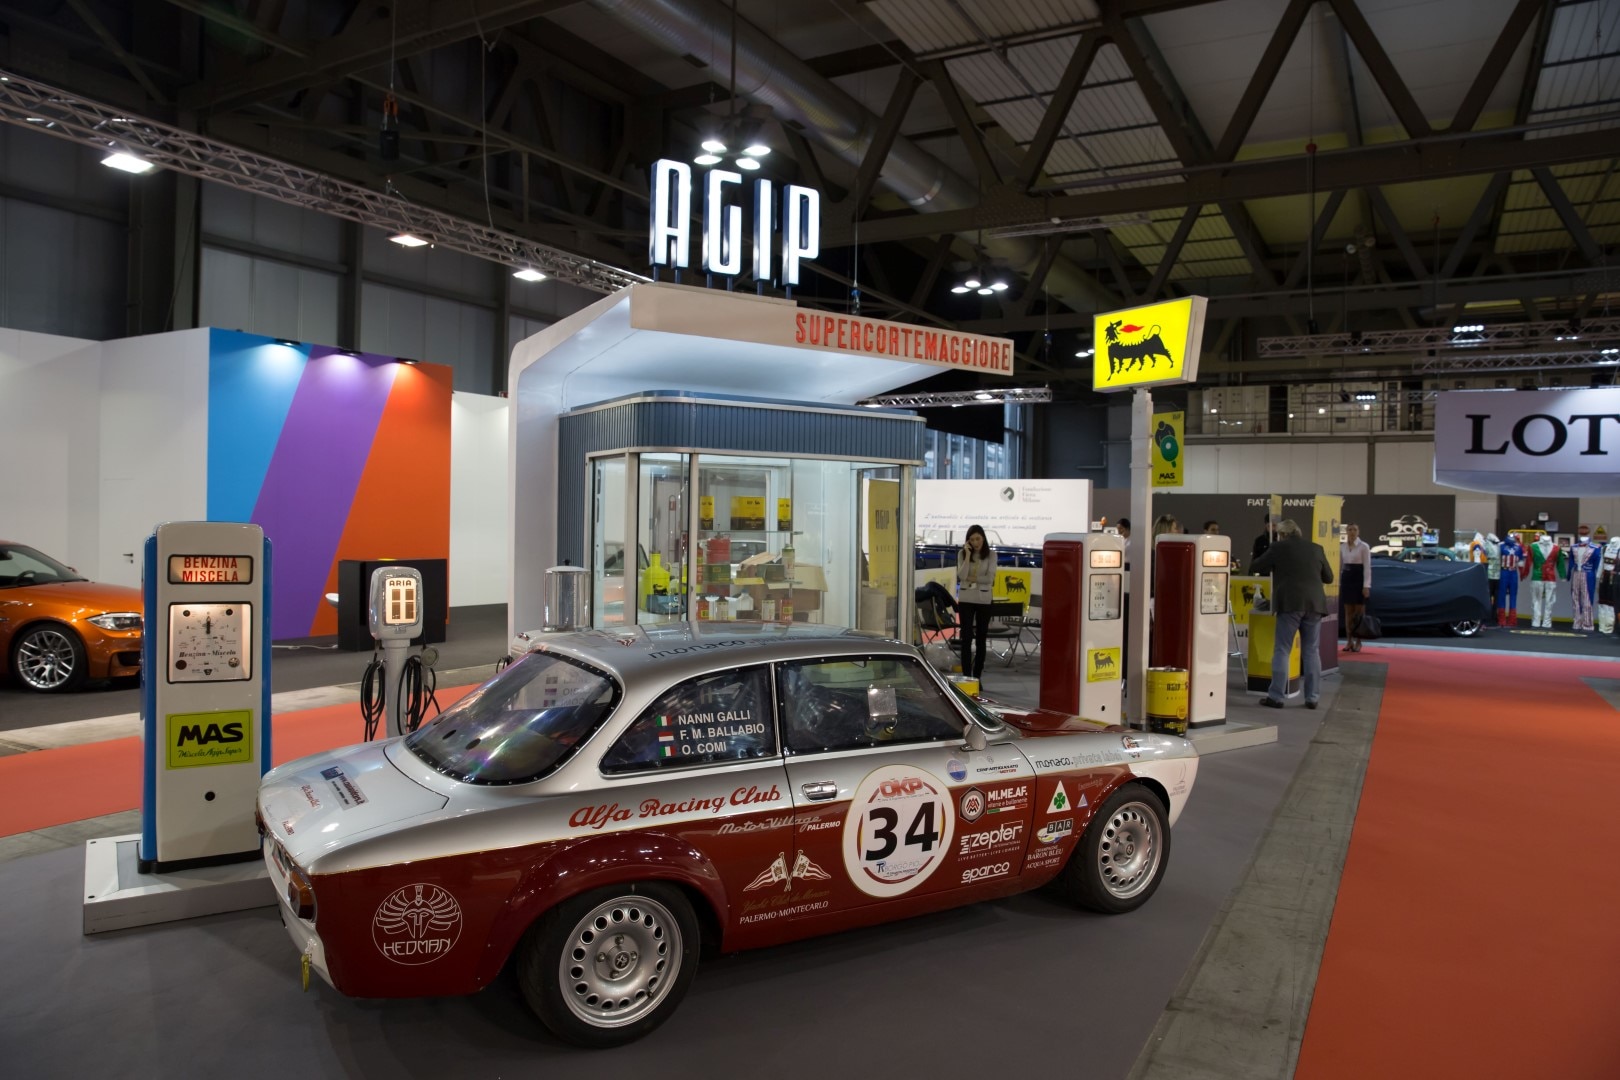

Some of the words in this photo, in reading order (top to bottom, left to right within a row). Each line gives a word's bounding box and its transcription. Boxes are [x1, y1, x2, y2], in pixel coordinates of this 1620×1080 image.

[649, 158, 821, 287] AGIP
[795, 312, 1011, 371] SUPERCORTEMAGGIORE
[1465, 413, 1620, 456] LOT
[184, 556, 238, 569] BENZINA
[182, 570, 239, 582] MISCELA
[678, 713, 715, 726] NANNI
[717, 710, 751, 721] GALLI
[177, 722, 244, 747] MAS
[680, 729, 689, 740] F.
[692, 728, 705, 739] M.
[707, 723, 765, 738] BALLABIO
[681, 745, 695, 755] O.
[697, 741, 727, 754] COMI
[879, 777, 924, 798] OKP
[568, 802, 634, 829] Alfa
[639, 796, 727, 818] Racing
[729, 784, 783, 806] Club
[807, 821, 840, 831] PALERMO
[865, 801, 939, 861] 34
[1049, 820, 1071, 832] BAR
[971, 824, 1023, 849] zepter
[1027, 851, 1049, 861] BARON
[962, 861, 1010, 883] sparco
[383, 938, 451, 956] HEDMAN
